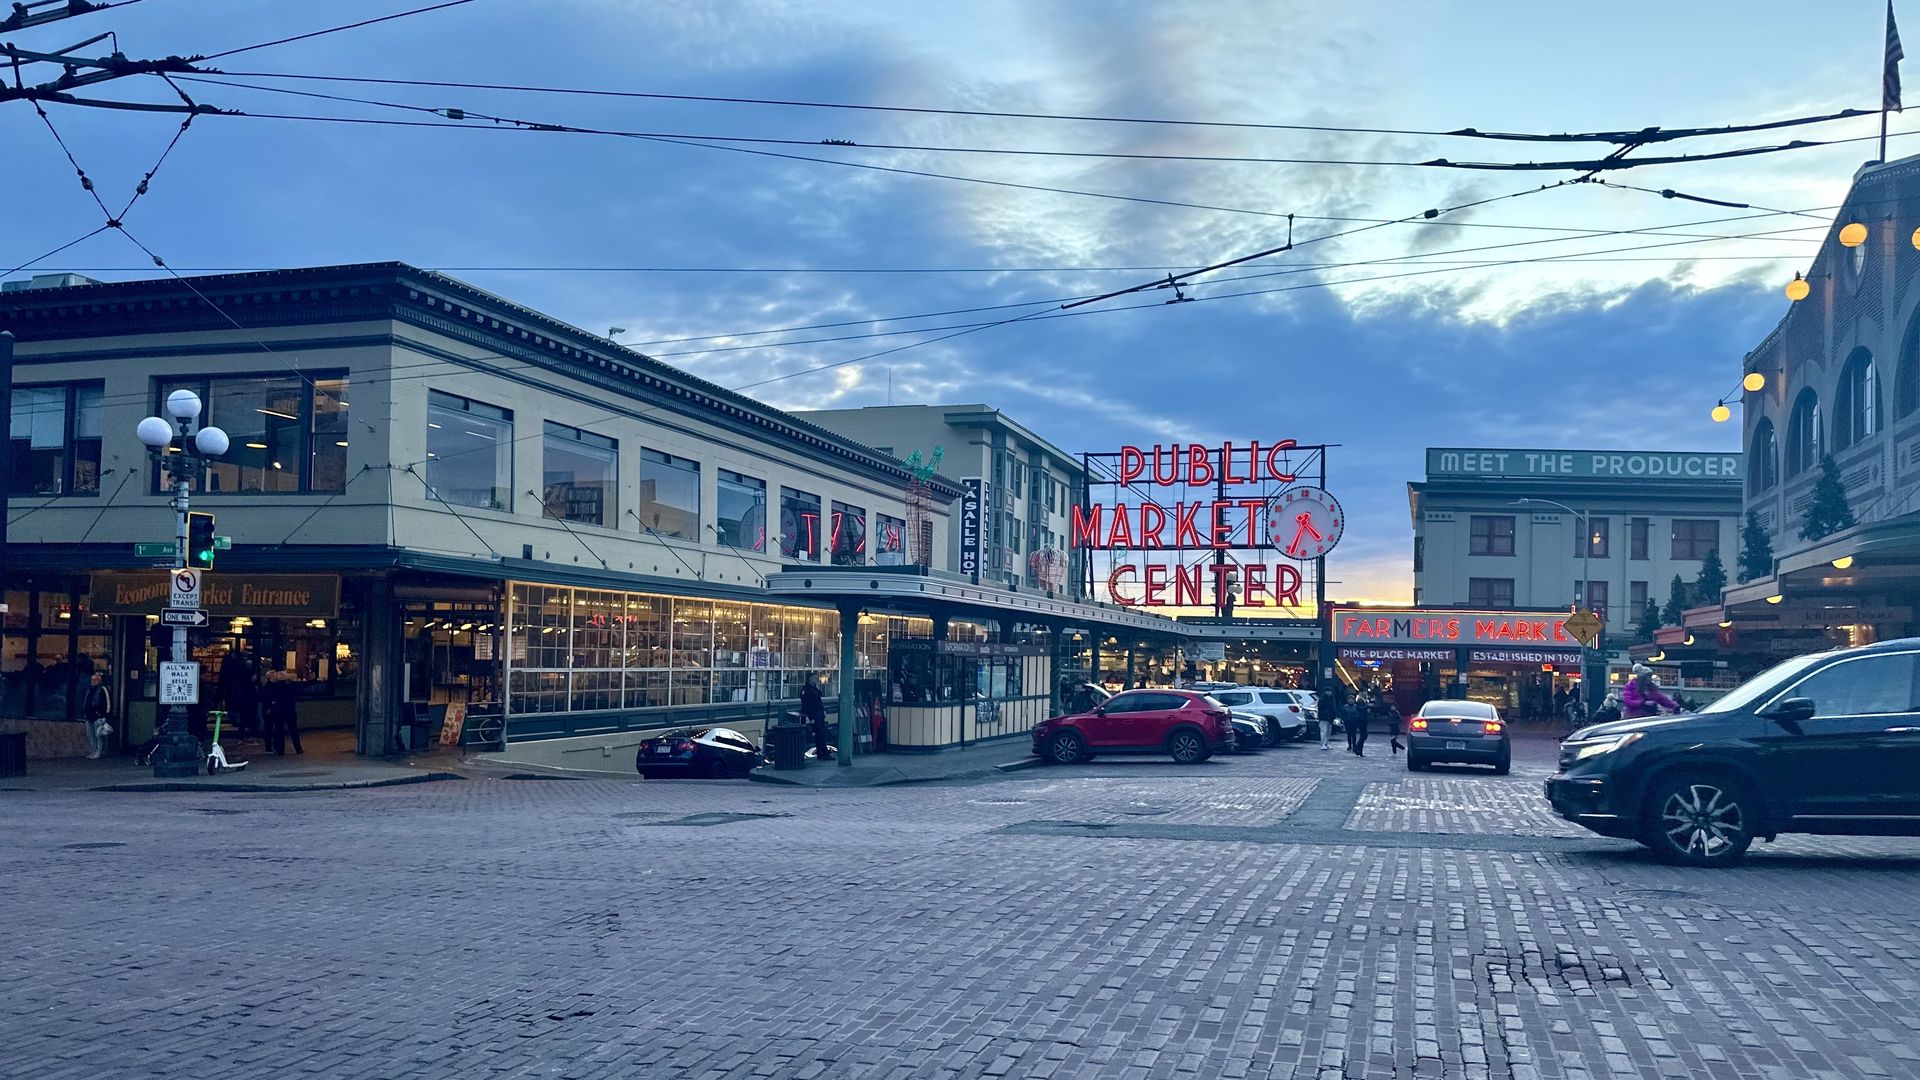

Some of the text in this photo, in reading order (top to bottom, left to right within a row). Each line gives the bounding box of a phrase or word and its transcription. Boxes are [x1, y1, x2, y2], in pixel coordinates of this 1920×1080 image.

[1121, 439, 1296, 487] PUBLIC
[1440, 452, 1737, 477] MEET THE PRODUCER
[964, 481, 977, 499] LA
[964, 501, 977, 546] SALLE
[1072, 500, 1267, 549] MARKET
[162, 546, 174, 554] Ave
[116, 581, 169, 606] Econom
[242, 584, 310, 605] Entrance
[1108, 564, 1301, 607] CENTER
[1343, 617, 1572, 641] FARMERS MARKE
[1343, 649, 1451, 660] PIKE PLACE MARKET
[1473, 651, 1542, 662] ESTABLISHED
[1544, 654, 1555, 662] IN
[1558, 654, 1581, 663] 1907
